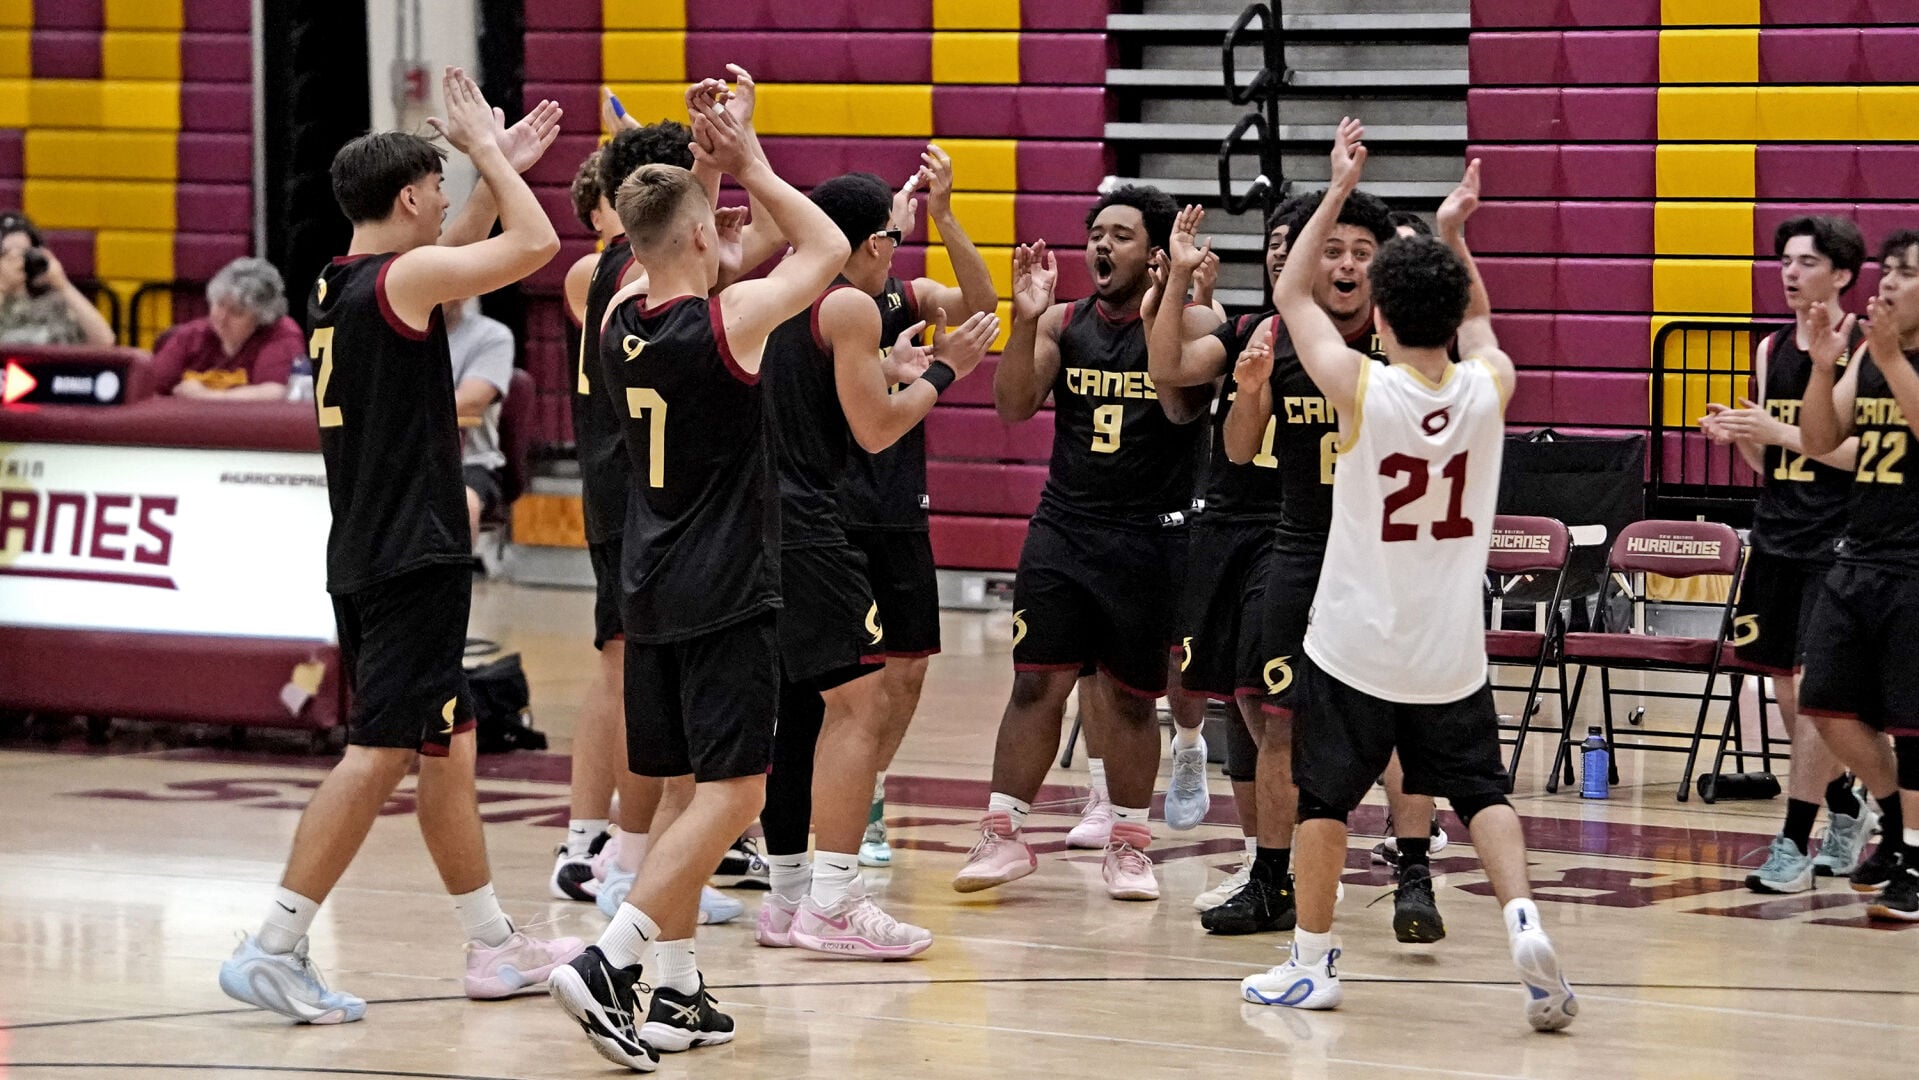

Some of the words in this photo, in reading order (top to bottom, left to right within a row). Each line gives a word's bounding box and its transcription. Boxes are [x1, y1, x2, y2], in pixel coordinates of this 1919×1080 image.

[309, 326, 343, 427] 2
[626, 387, 668, 488] 7
[1091, 404, 1124, 453] 9
[1856, 430, 1908, 484] 22
[1378, 449, 1474, 542] 21
[1626, 537, 1721, 556] HURRICANES
